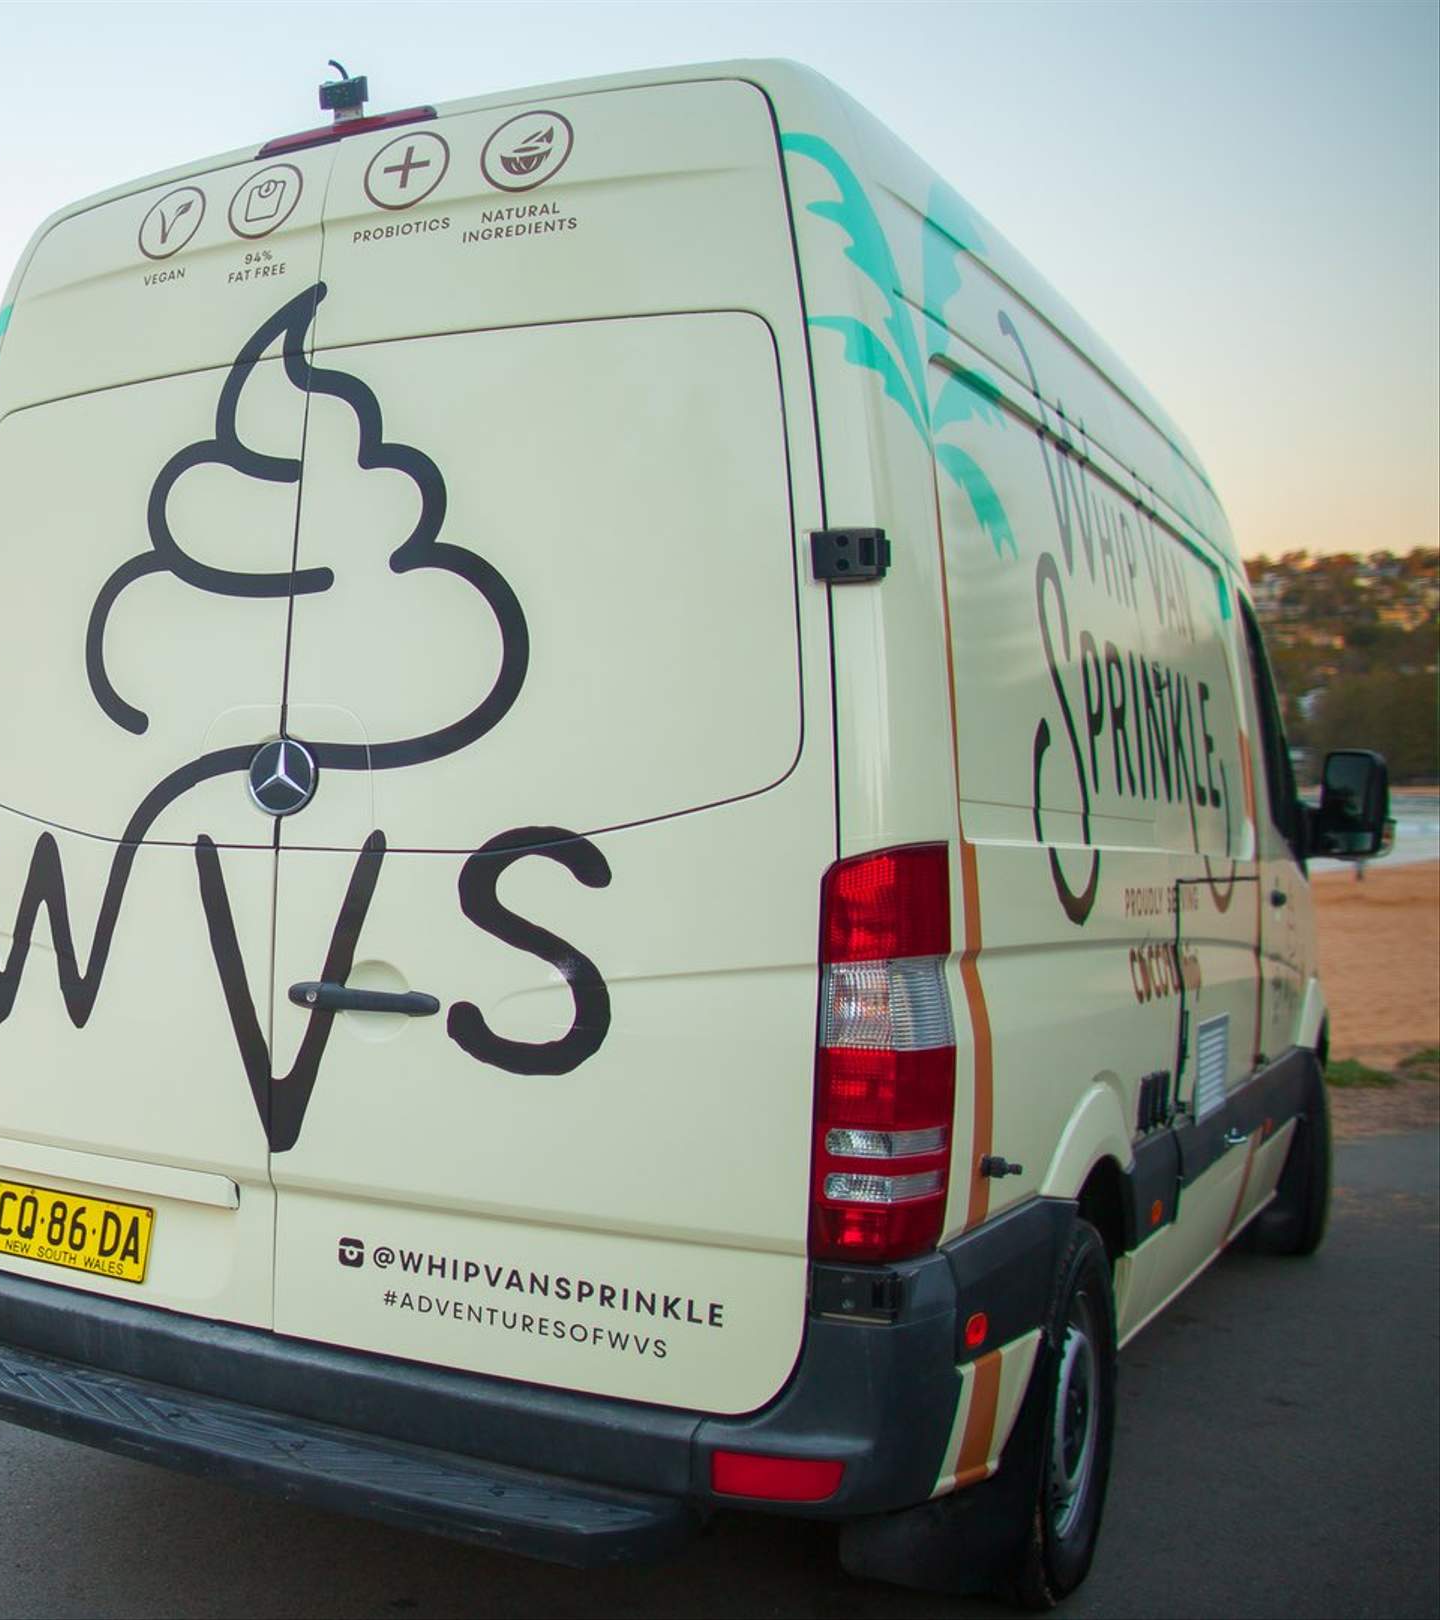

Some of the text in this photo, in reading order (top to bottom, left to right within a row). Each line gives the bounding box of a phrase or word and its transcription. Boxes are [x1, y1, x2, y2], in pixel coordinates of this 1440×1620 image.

[480, 201, 561, 224] NATURAL
[352, 216, 451, 243] PROBIOTICS
[461, 217, 578, 244] INGREDIENTS
[244, 249, 273, 265] 94%
[143, 267, 186, 287] VEGAN
[227, 262, 287, 284] FAT FREE
[1032, 551, 1238, 927] SPRINKLE
[1123, 886, 1163, 917] PROUDLY
[4, 1239, 124, 1276] NEW SOUTH WALES
[372, 1245, 725, 1328] @WHIPVANSPRINKLE
[383, 1289, 667, 1359] #ADVENTURESOFWVS
